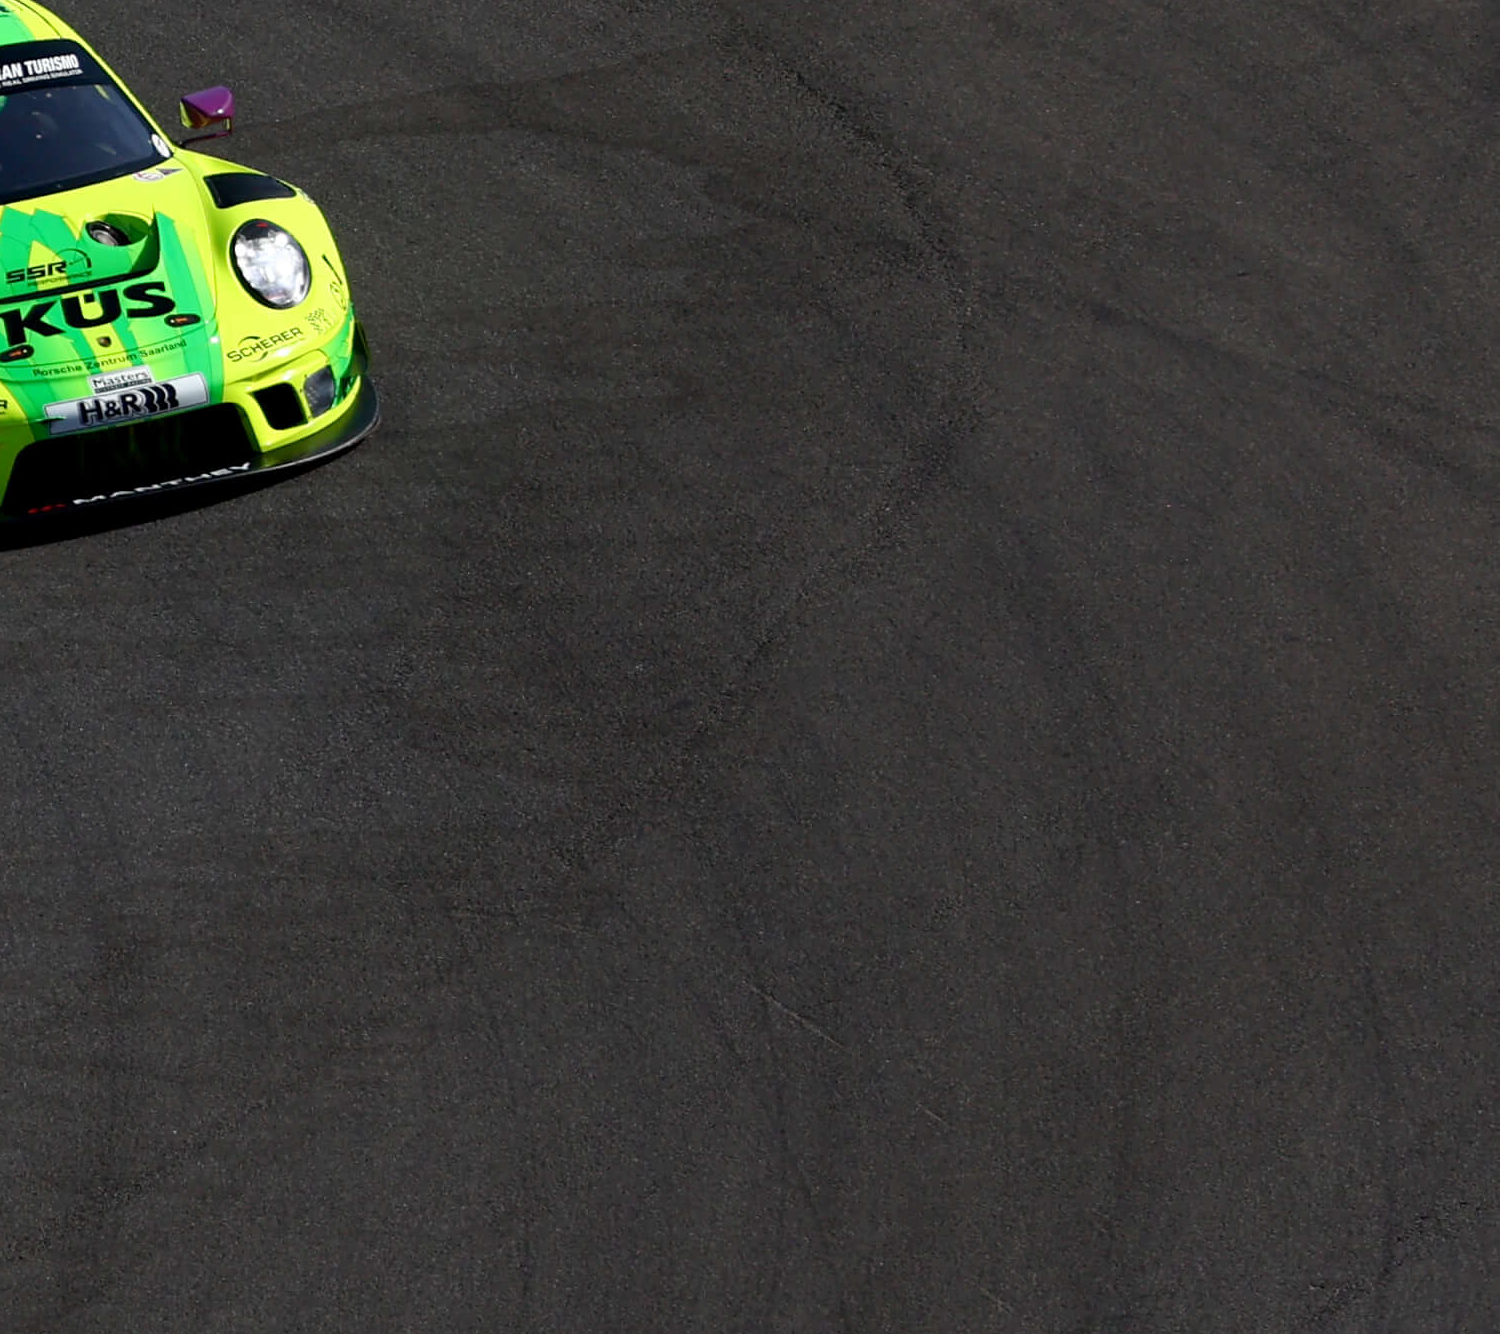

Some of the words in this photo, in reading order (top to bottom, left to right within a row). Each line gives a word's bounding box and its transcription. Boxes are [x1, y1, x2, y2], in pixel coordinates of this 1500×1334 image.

[23, 53, 80, 75] TURISMO
[5, 260, 67, 285] SSR
[32, 360, 84, 377] Porsche
[85, 352, 138, 371] Zentrum
[138, 338, 188, 359] Saarland
[226, 326, 304, 363] SCHERER
[91, 370, 149, 389] Masters
[76, 393, 141, 425] H&R
